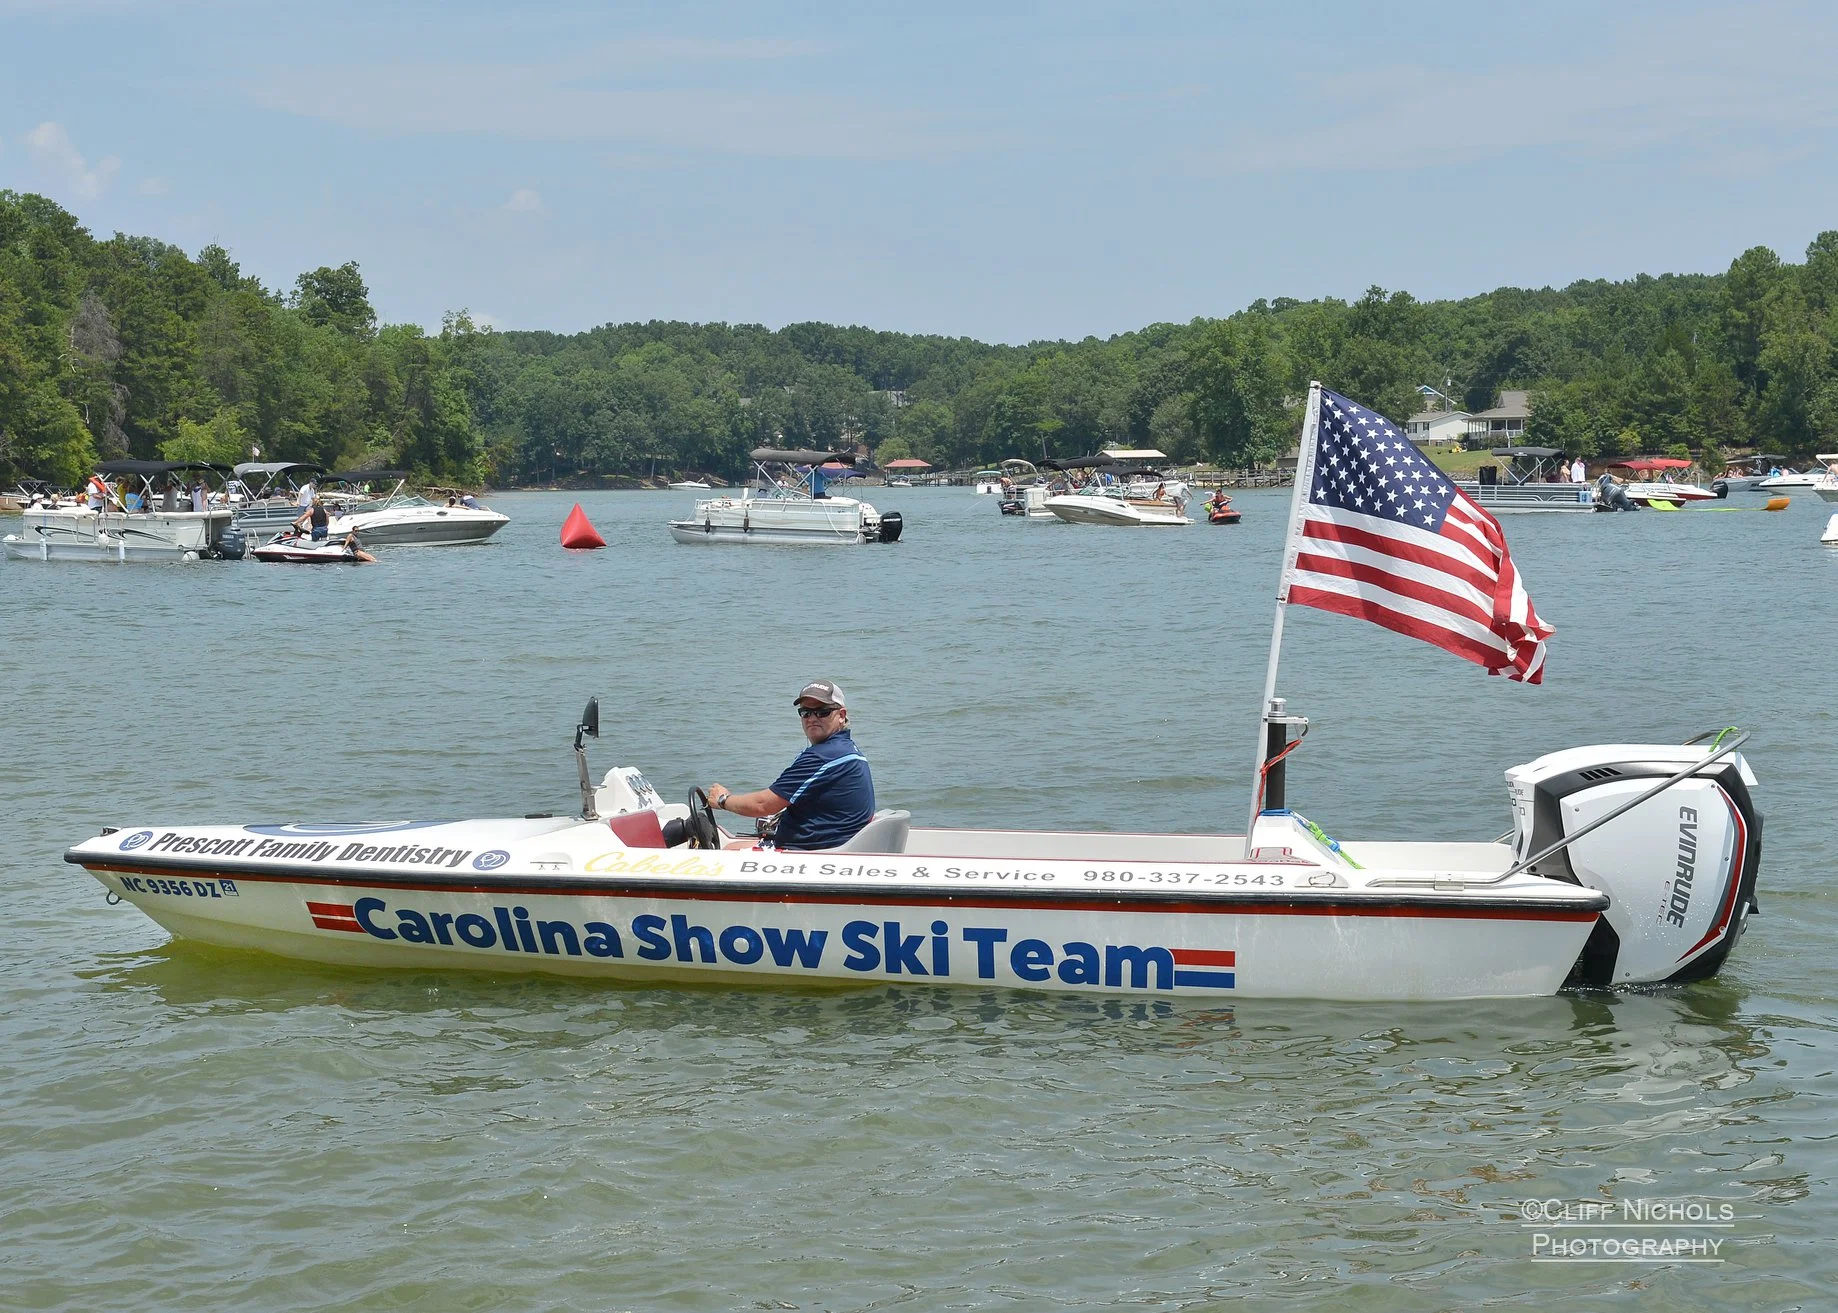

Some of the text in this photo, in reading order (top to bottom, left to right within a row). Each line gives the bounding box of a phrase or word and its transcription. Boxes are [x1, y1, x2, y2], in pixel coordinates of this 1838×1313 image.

[147, 833, 473, 868] Prescott Family Dentistry
[1666, 805, 1698, 929] EVINRUDE
[119, 876, 222, 899] NC 9356 DZ
[740, 861, 808, 875] Boat
[818, 863, 898, 878] Sales
[911, 866, 931, 878] &
[943, 867, 1057, 881] Service
[1083, 870, 1286, 886] 980-337-2543
[354, 898, 1174, 990] Carolina Show Ski Team
